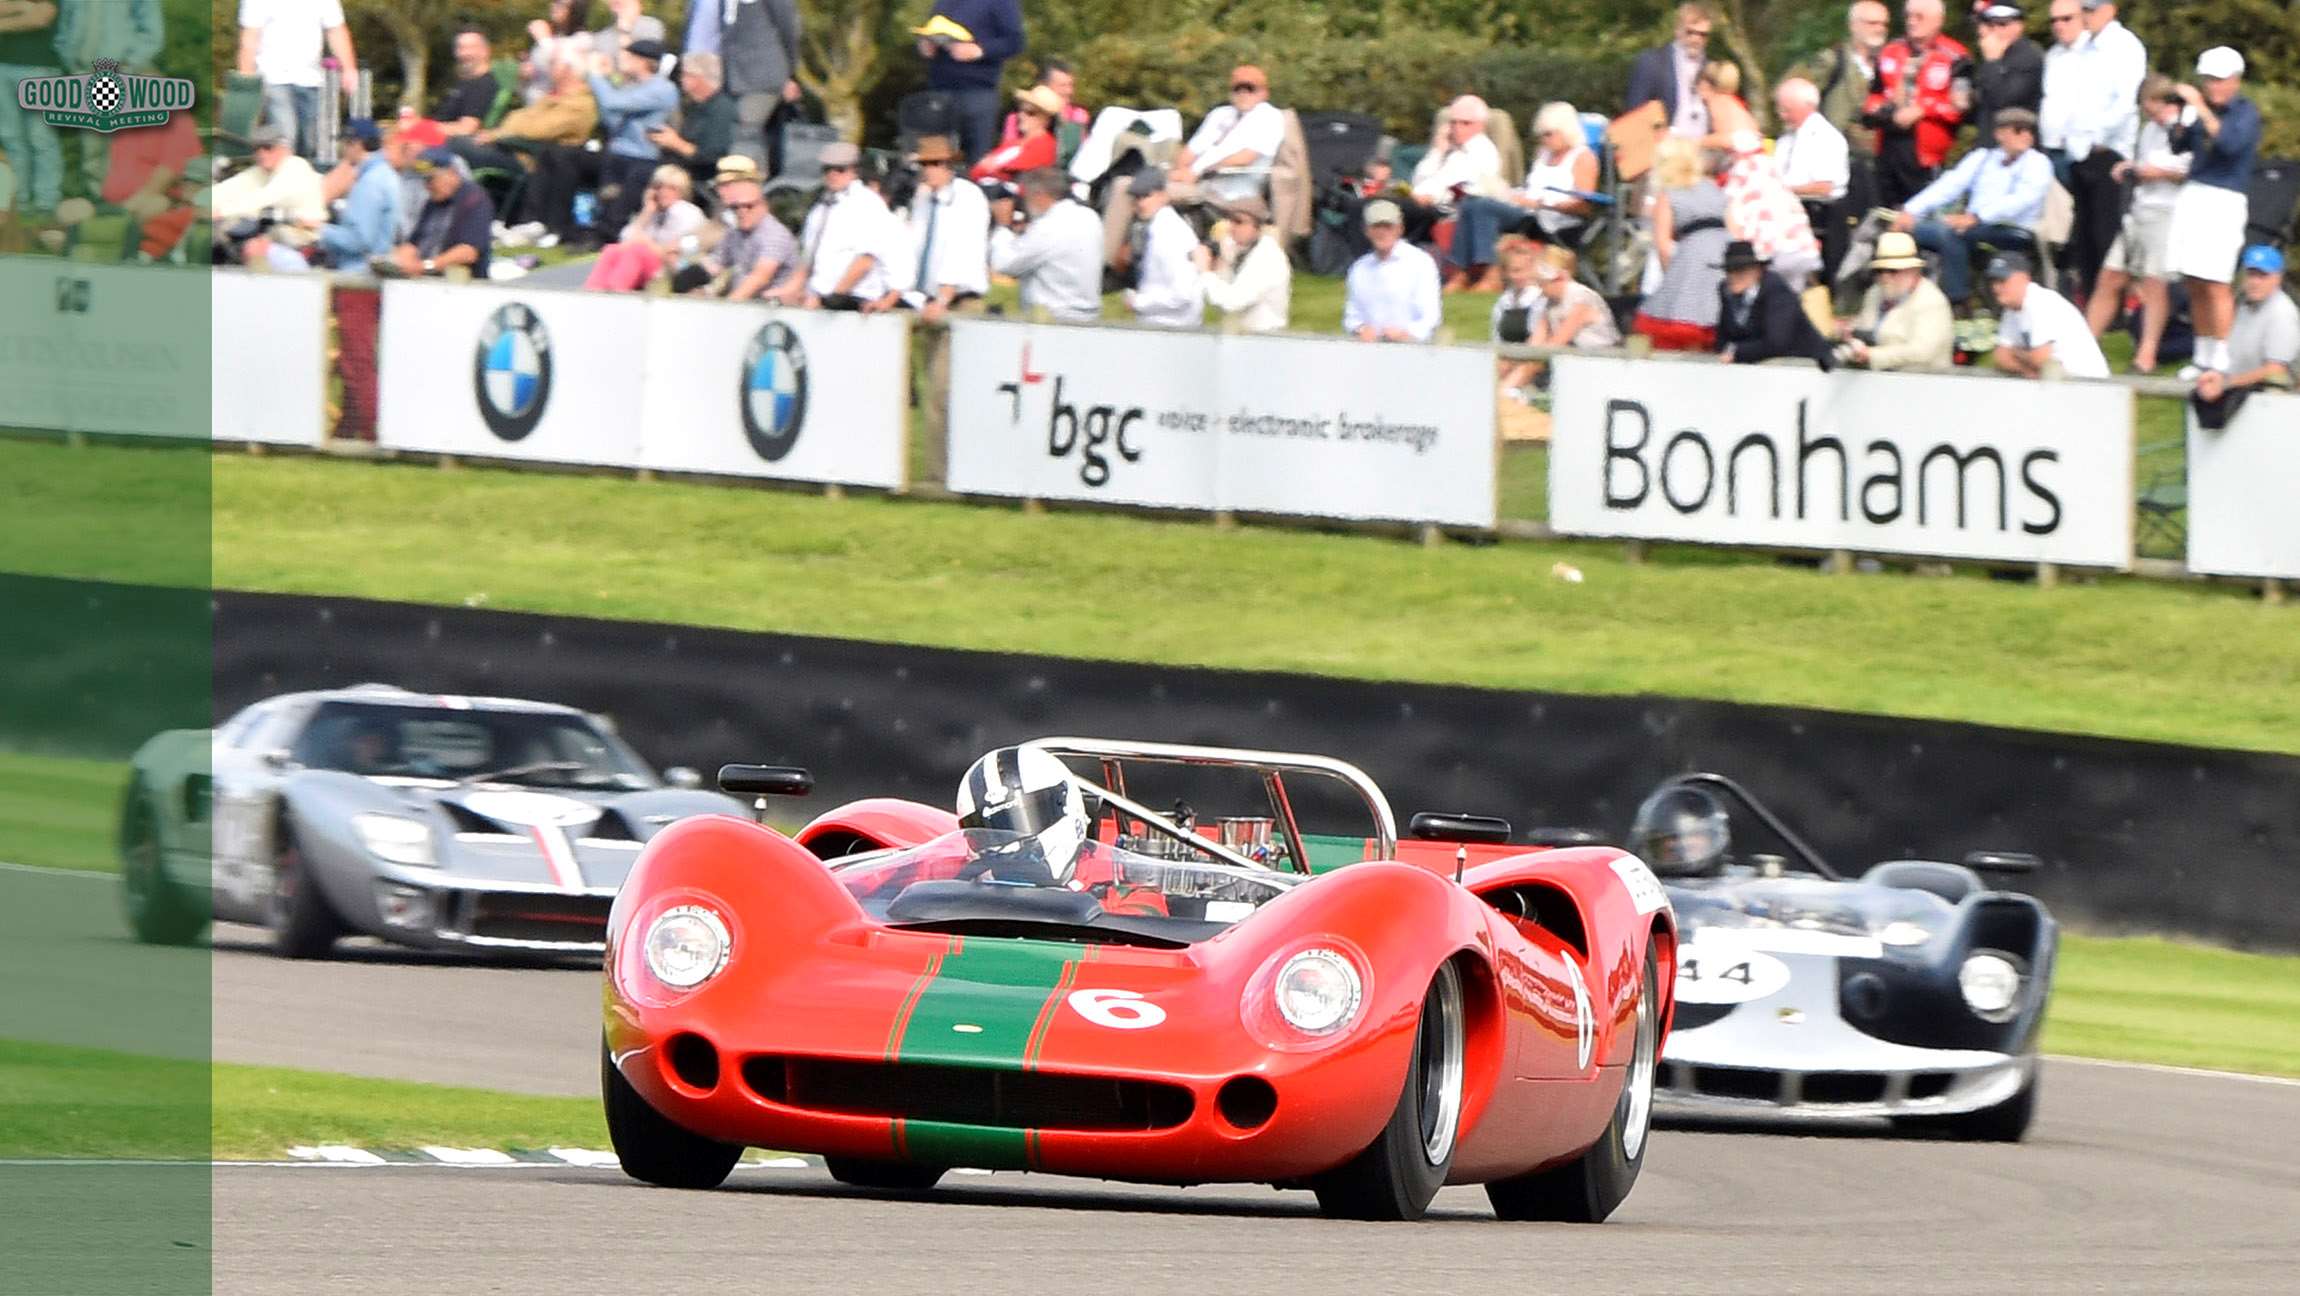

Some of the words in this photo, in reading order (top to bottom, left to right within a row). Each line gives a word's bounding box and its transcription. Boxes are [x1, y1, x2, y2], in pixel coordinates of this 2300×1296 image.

[1049, 375, 1145, 488] bgc
[1228, 404, 1332, 439] electronic
[1337, 410, 1439, 453] brokerage
[1603, 398, 2063, 536] Bonhams
[1068, 988, 1167, 1029] 6
